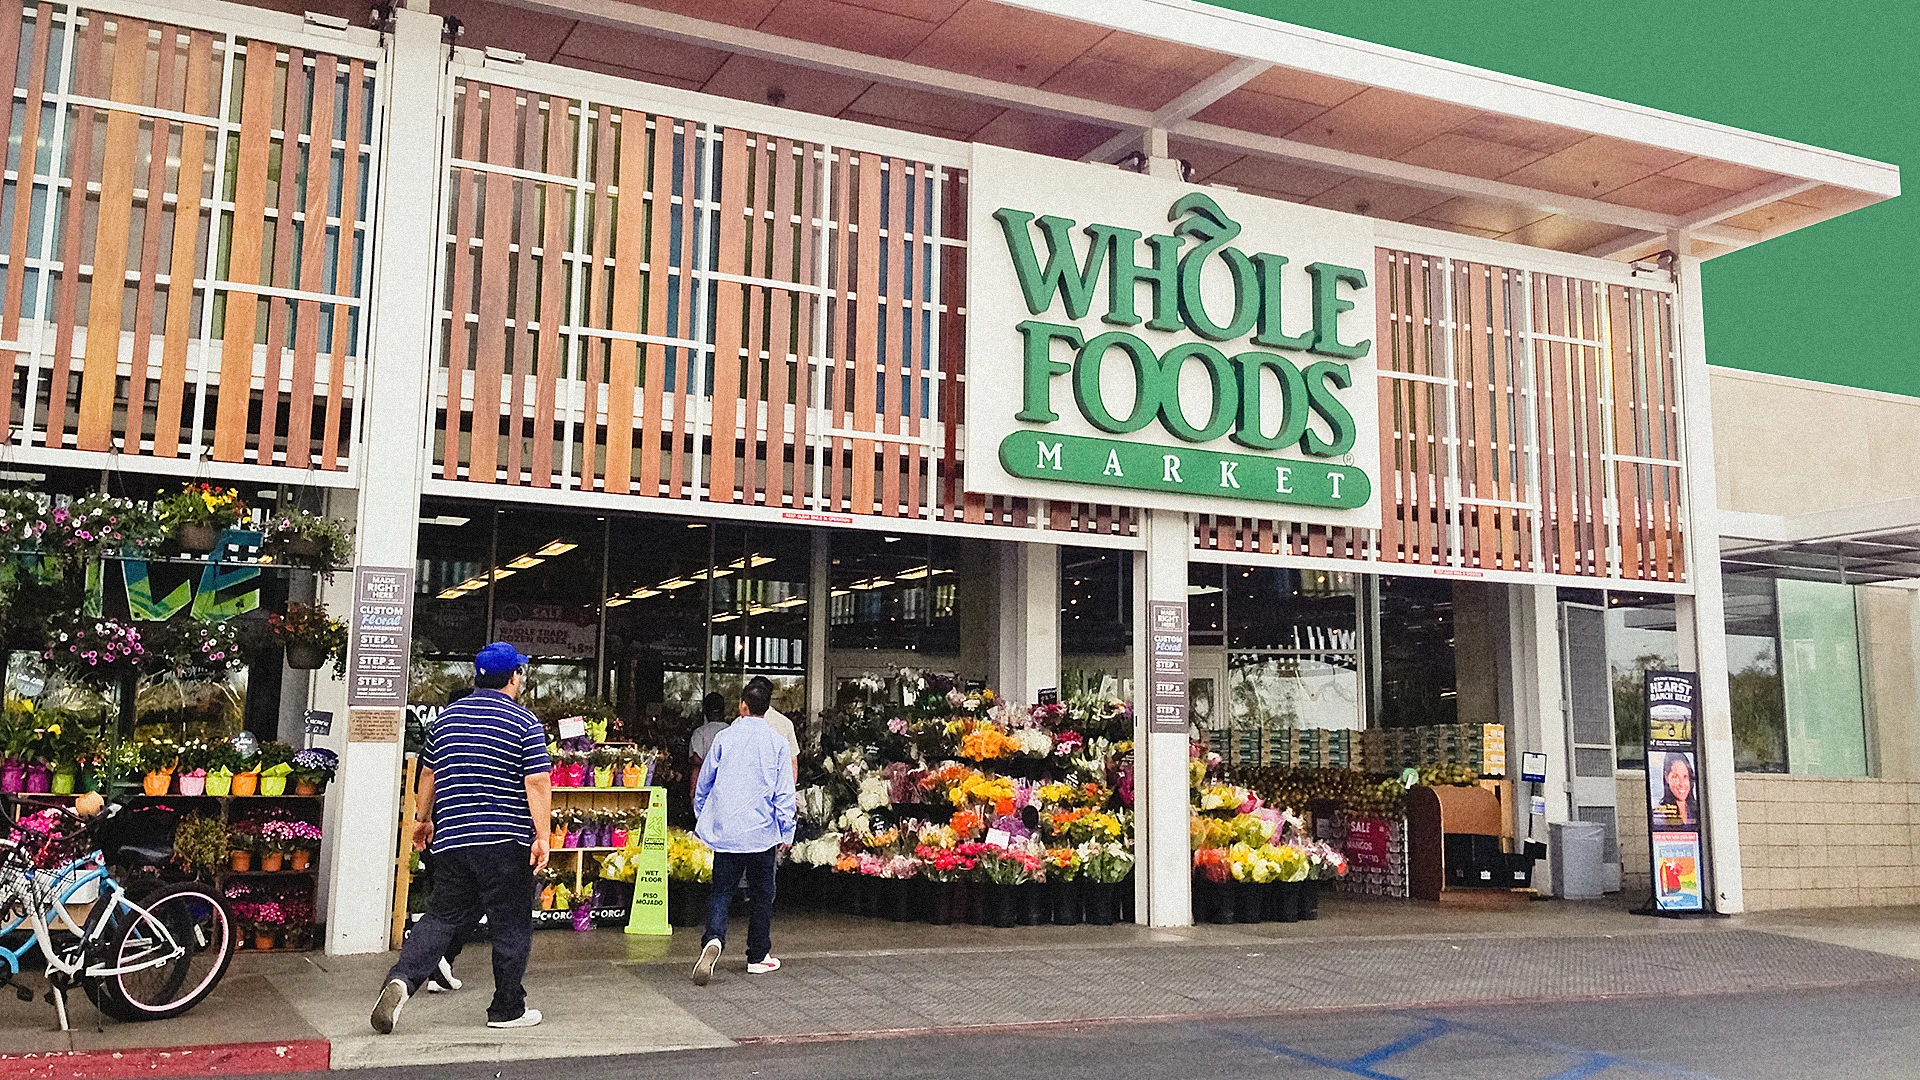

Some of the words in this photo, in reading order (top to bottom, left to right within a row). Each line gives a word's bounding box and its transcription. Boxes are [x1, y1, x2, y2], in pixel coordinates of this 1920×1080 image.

[992, 193, 1371, 359] WHOLE
[1015, 320, 1356, 458] FOODS
[1037, 441, 1345, 499] MARKET
[372, 576, 396, 584] MADE
[367, 583, 400, 593] RIGHT
[372, 591, 394, 599] HERE
[360, 605, 404, 616] CUSTOM
[361, 614, 402, 626] Floral
[360, 635, 388, 644] STEP
[389, 637, 395, 645] 1
[359, 656, 387, 665] STEP
[388, 658, 395, 666] 2
[1156, 661, 1175, 669] STEP
[357, 676, 386, 686] STEP
[386, 679, 393, 688] 3
[1156, 684, 1175, 692] STEP
[1650, 681, 1693, 696] HEARST
[1156, 706, 1175, 715] STEP
[1350, 821, 1371, 833] SALE
